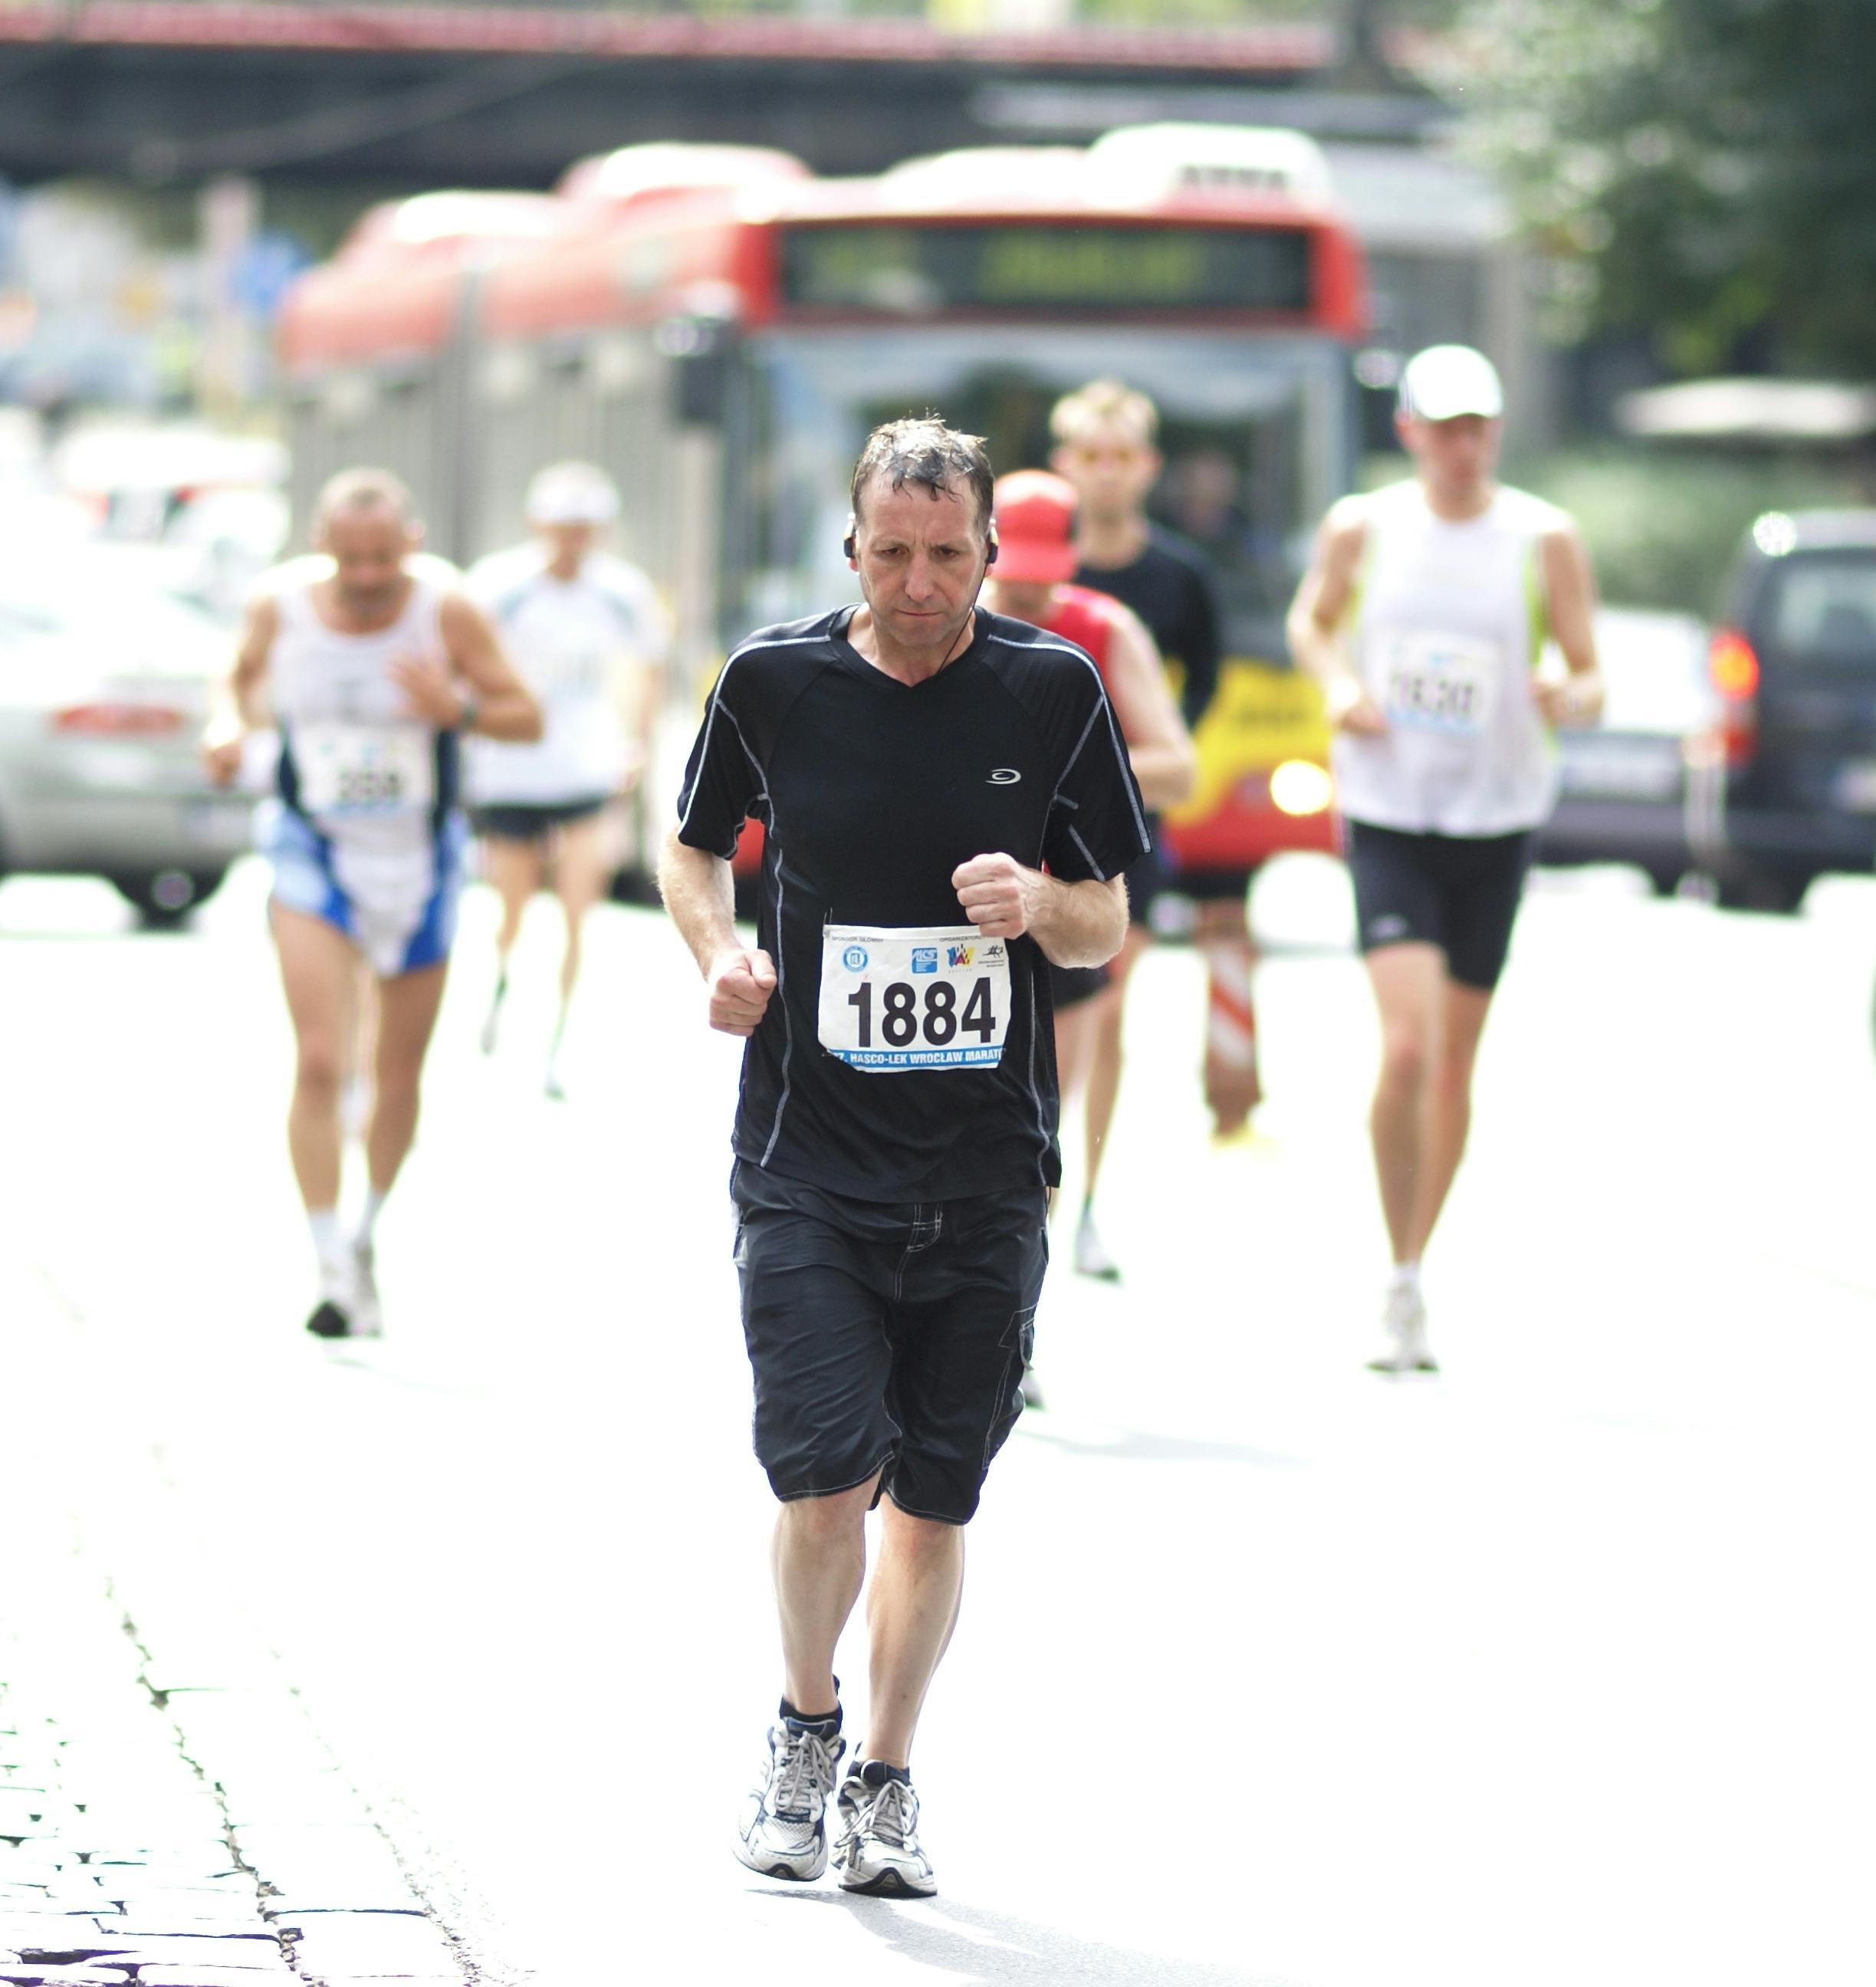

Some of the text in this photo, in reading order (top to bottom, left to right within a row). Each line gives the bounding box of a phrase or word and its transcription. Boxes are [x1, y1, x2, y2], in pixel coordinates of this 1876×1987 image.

[848, 977, 996, 1048] 1884
[850, 1053, 908, 1065] HASCO-LEK
[909, 1051, 964, 1064] WROCŁAW
